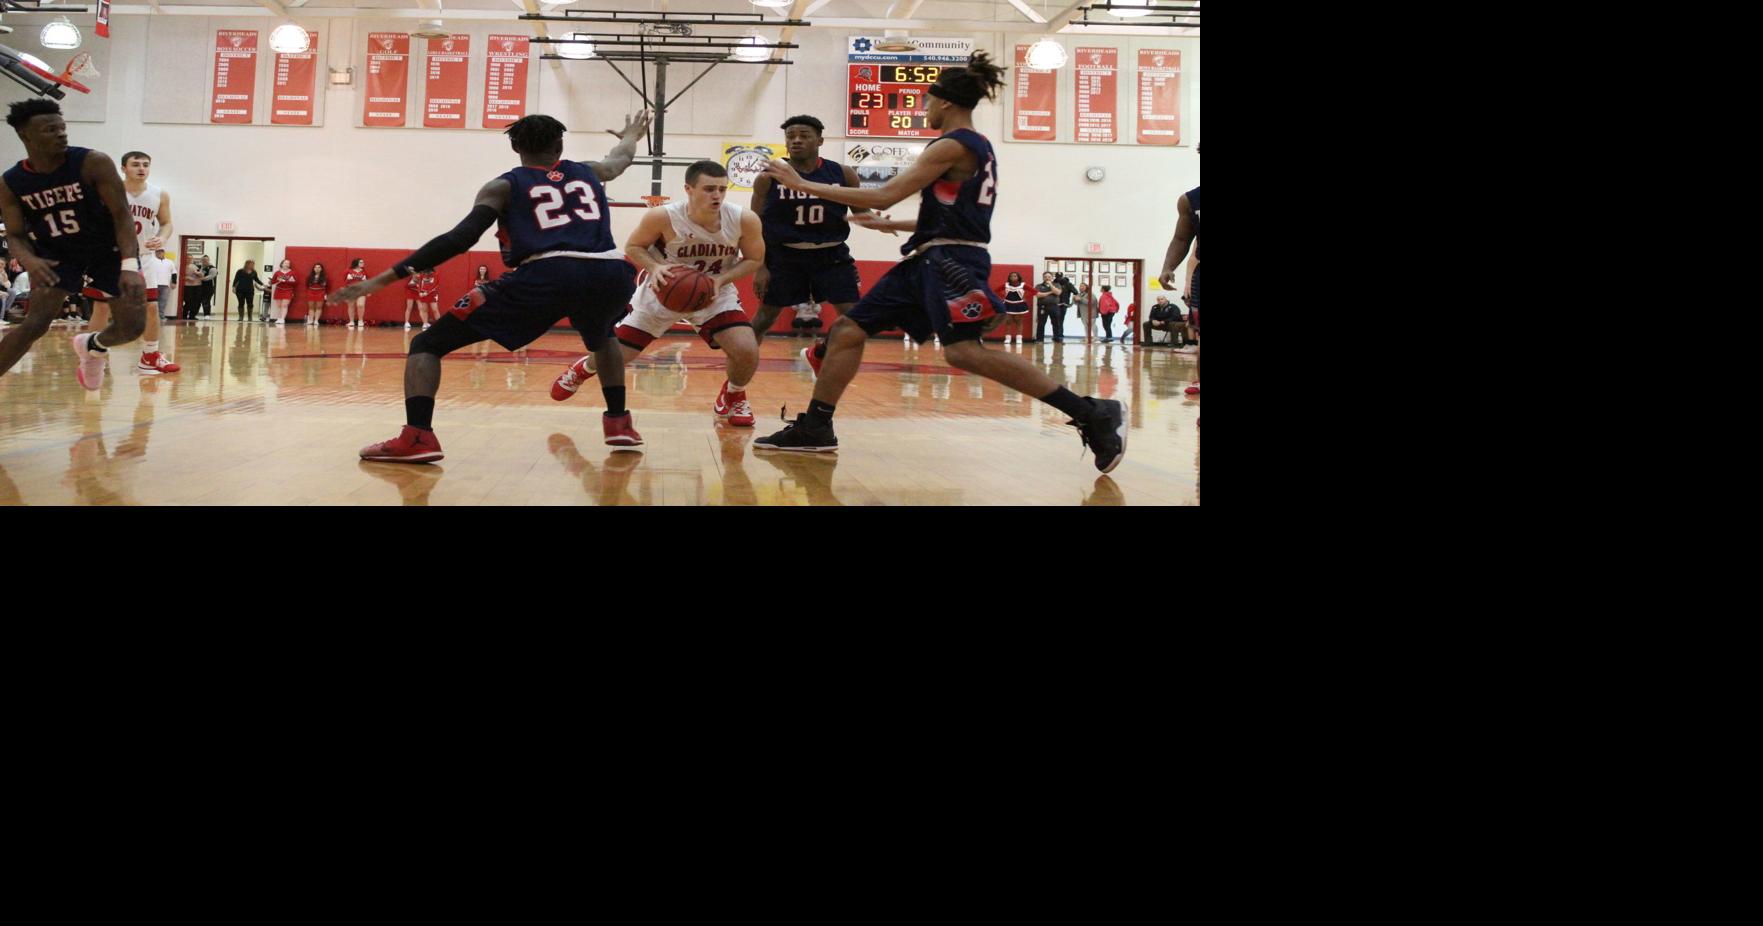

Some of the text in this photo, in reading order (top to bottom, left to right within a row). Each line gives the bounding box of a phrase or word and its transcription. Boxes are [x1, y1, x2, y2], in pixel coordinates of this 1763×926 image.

[895, 67, 938, 83] 6:52
[855, 84, 881, 92] HOME
[859, 93, 883, 109] 23
[906, 95, 915, 108] 3
[863, 117, 867, 127] 1
[891, 116, 911, 128] 20
[977, 160, 995, 206] 2
[21, 182, 84, 210] TIGERS
[529, 180, 601, 230] 23
[44, 209, 81, 237] 15
[795, 205, 824, 225] 10
[693, 259, 723, 274] 24
